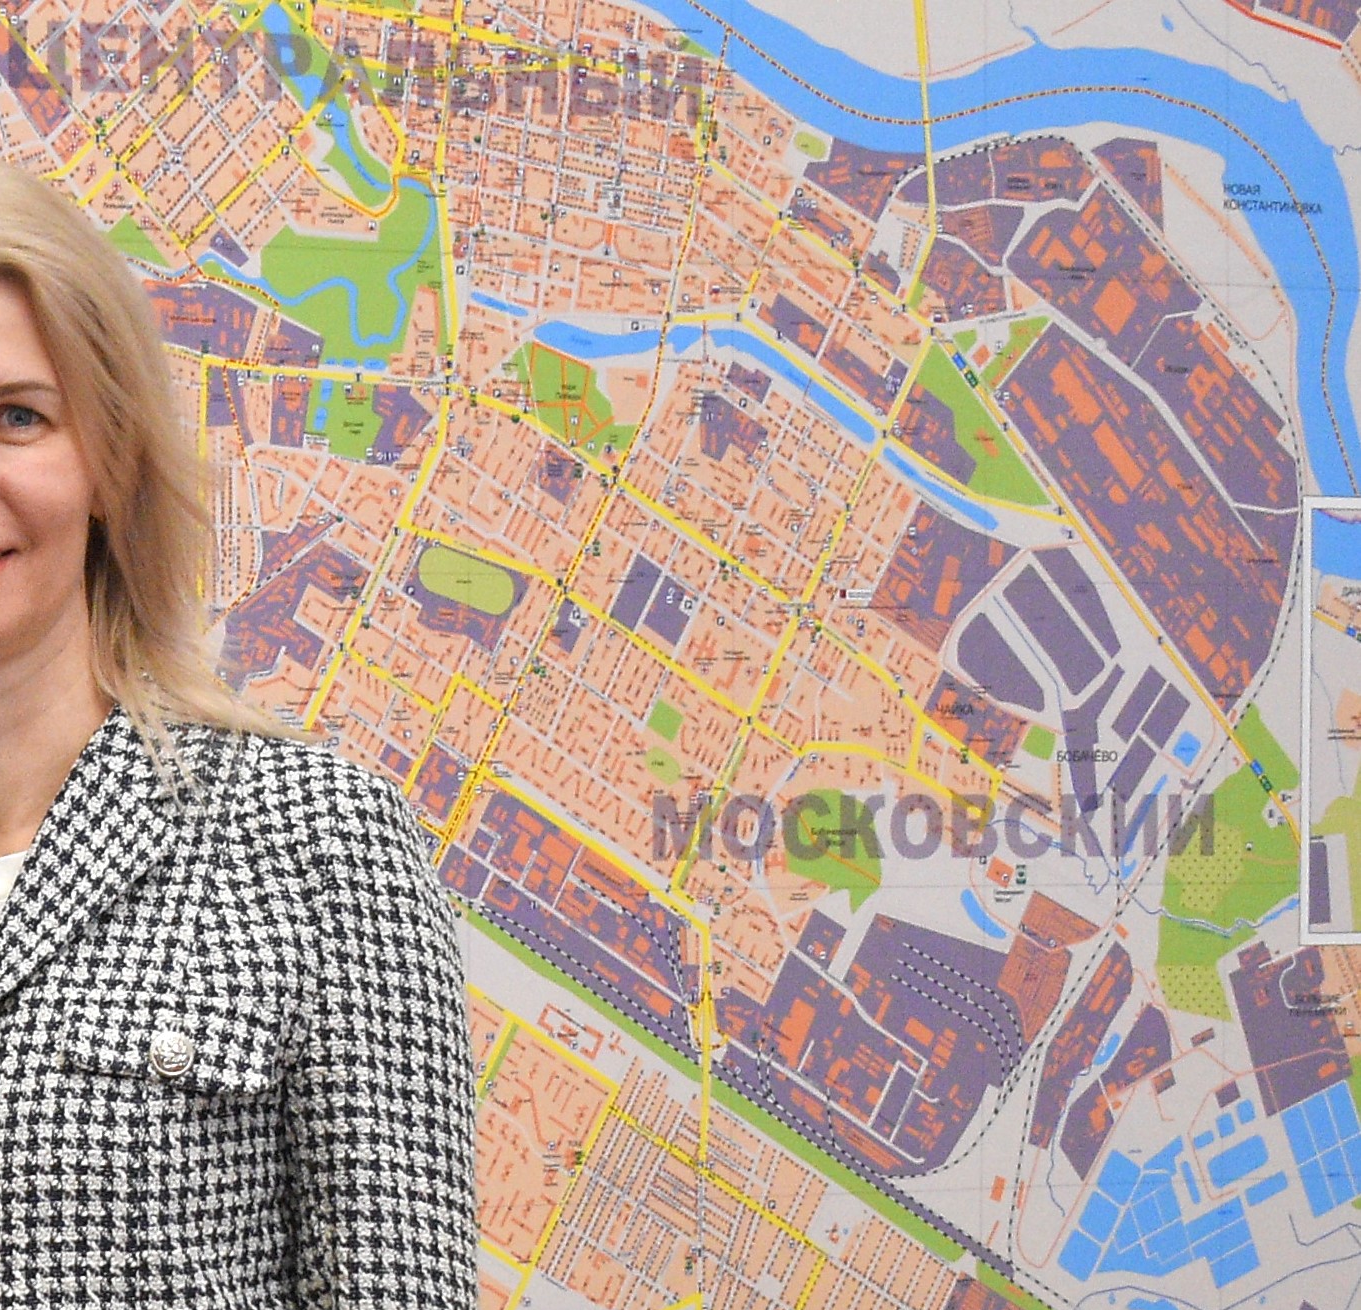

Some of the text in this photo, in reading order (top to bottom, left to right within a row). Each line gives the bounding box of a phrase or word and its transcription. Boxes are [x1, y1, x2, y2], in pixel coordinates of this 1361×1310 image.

[8, 19, 704, 124] ЦЕНТРАЛЬНЫЙ
[1223, 183, 1261, 196] НОВАЯ
[1223, 199, 1323, 215] КОНСТАНТИНОВКА
[651, 779, 1215, 861] МОСКОВСКИЙ
